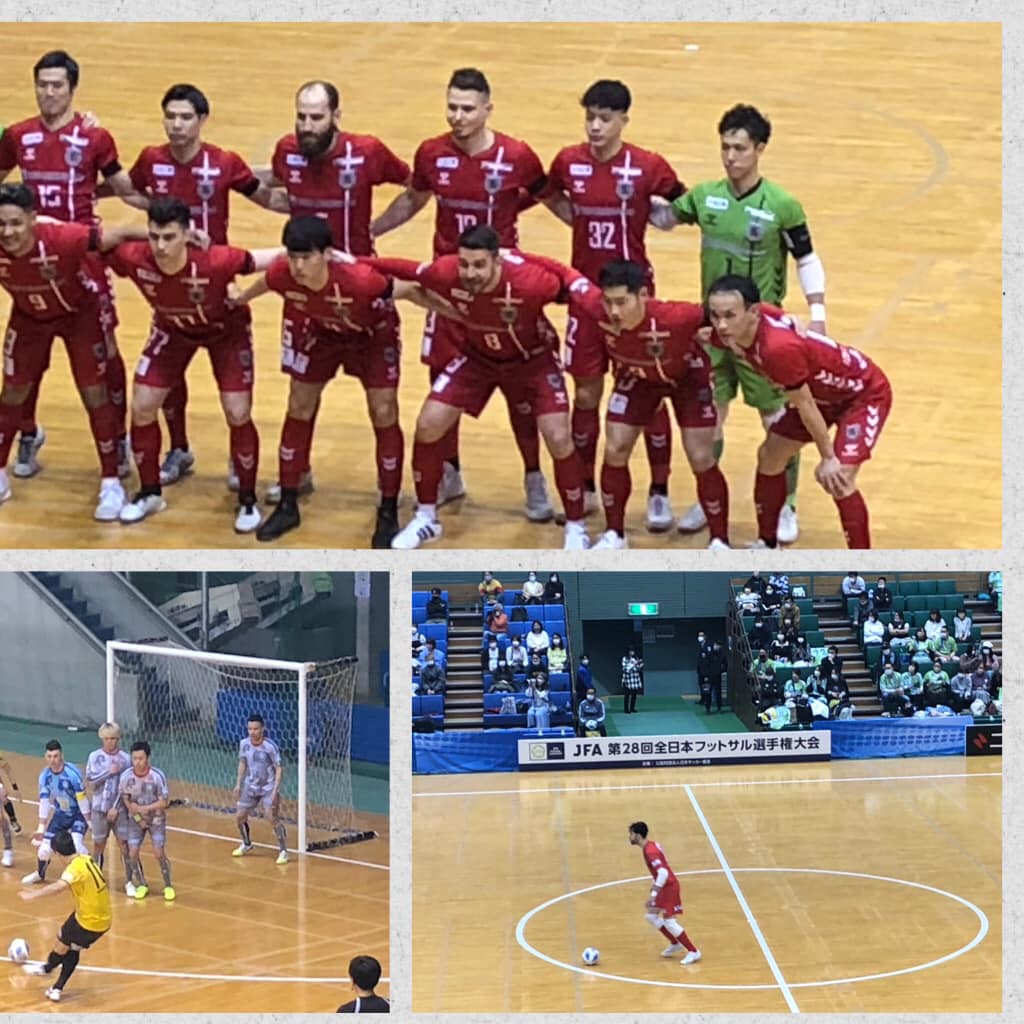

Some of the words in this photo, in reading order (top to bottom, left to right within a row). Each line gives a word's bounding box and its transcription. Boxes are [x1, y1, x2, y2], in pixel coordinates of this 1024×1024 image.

[37, 184, 61, 208] 15
[588, 221, 617, 250] 32
[573, 743, 603, 758] JFA
[608, 736, 821, 757] 第28回全日本フットサル選手権大会
